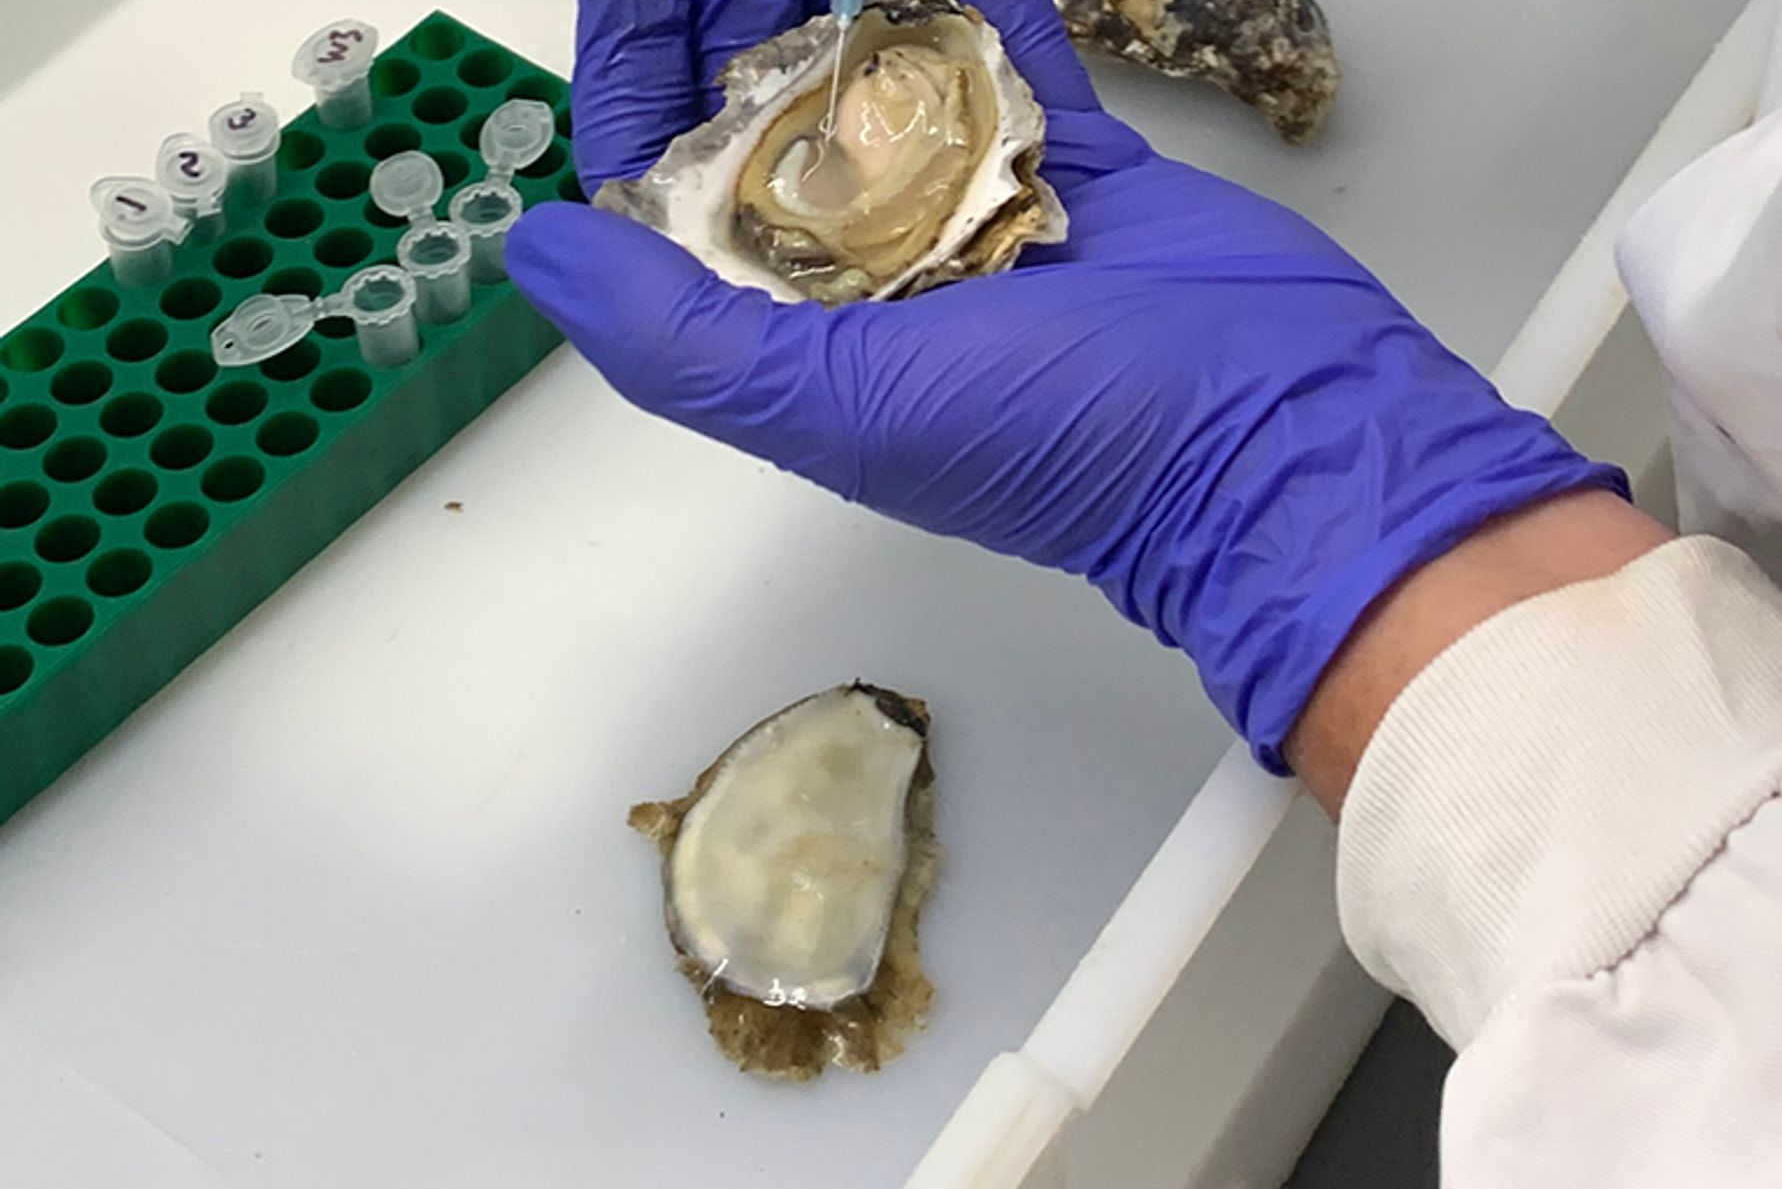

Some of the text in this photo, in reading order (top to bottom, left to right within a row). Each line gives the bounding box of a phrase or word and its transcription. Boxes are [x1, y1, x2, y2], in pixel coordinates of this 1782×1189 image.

[226, 107, 257, 131] 3
[178, 150, 201, 179] 2
[115, 195, 148, 213] 1
